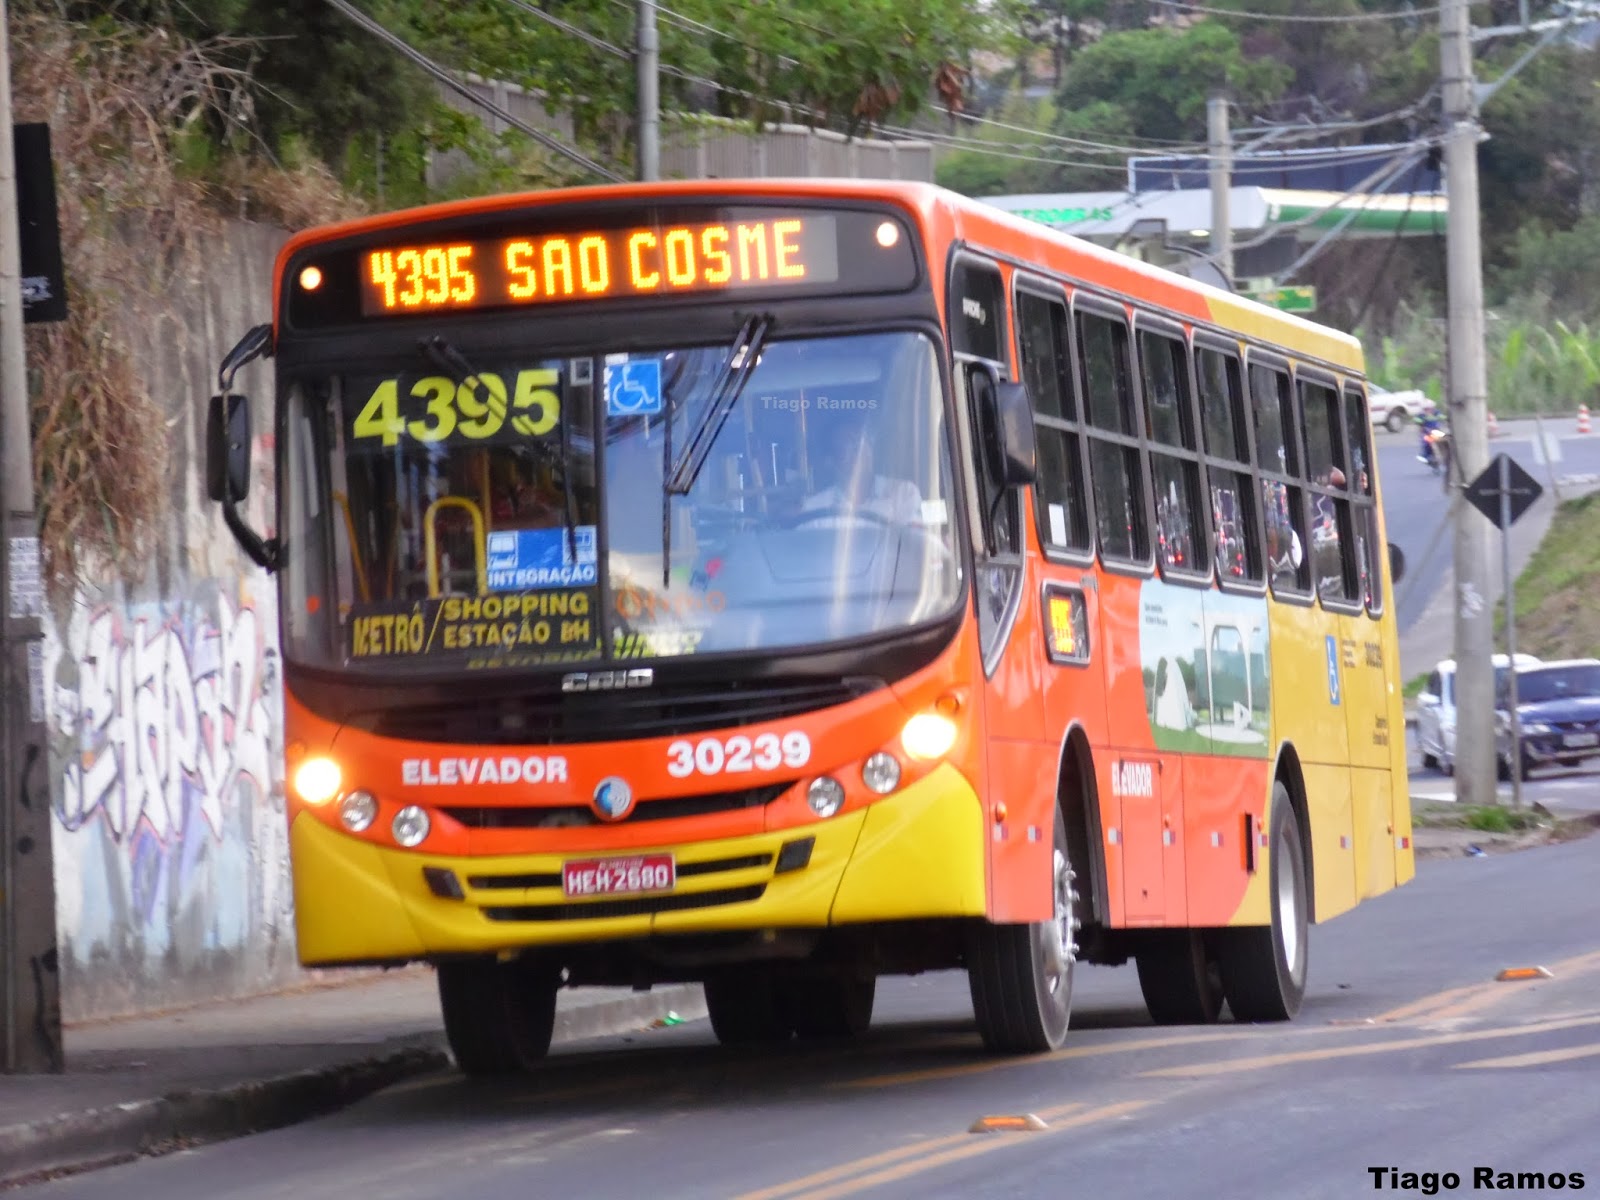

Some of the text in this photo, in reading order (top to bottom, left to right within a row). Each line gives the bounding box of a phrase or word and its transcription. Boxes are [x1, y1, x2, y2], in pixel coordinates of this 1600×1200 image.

[371, 220, 805, 307] 4395 SAO COSME
[353, 368, 561, 447] 4395
[443, 592, 590, 622] SHOPPING
[443, 617, 591, 651] ESTAÇÃO BH
[401, 756, 568, 786] ELEVADOR
[667, 731, 811, 778] 30239
